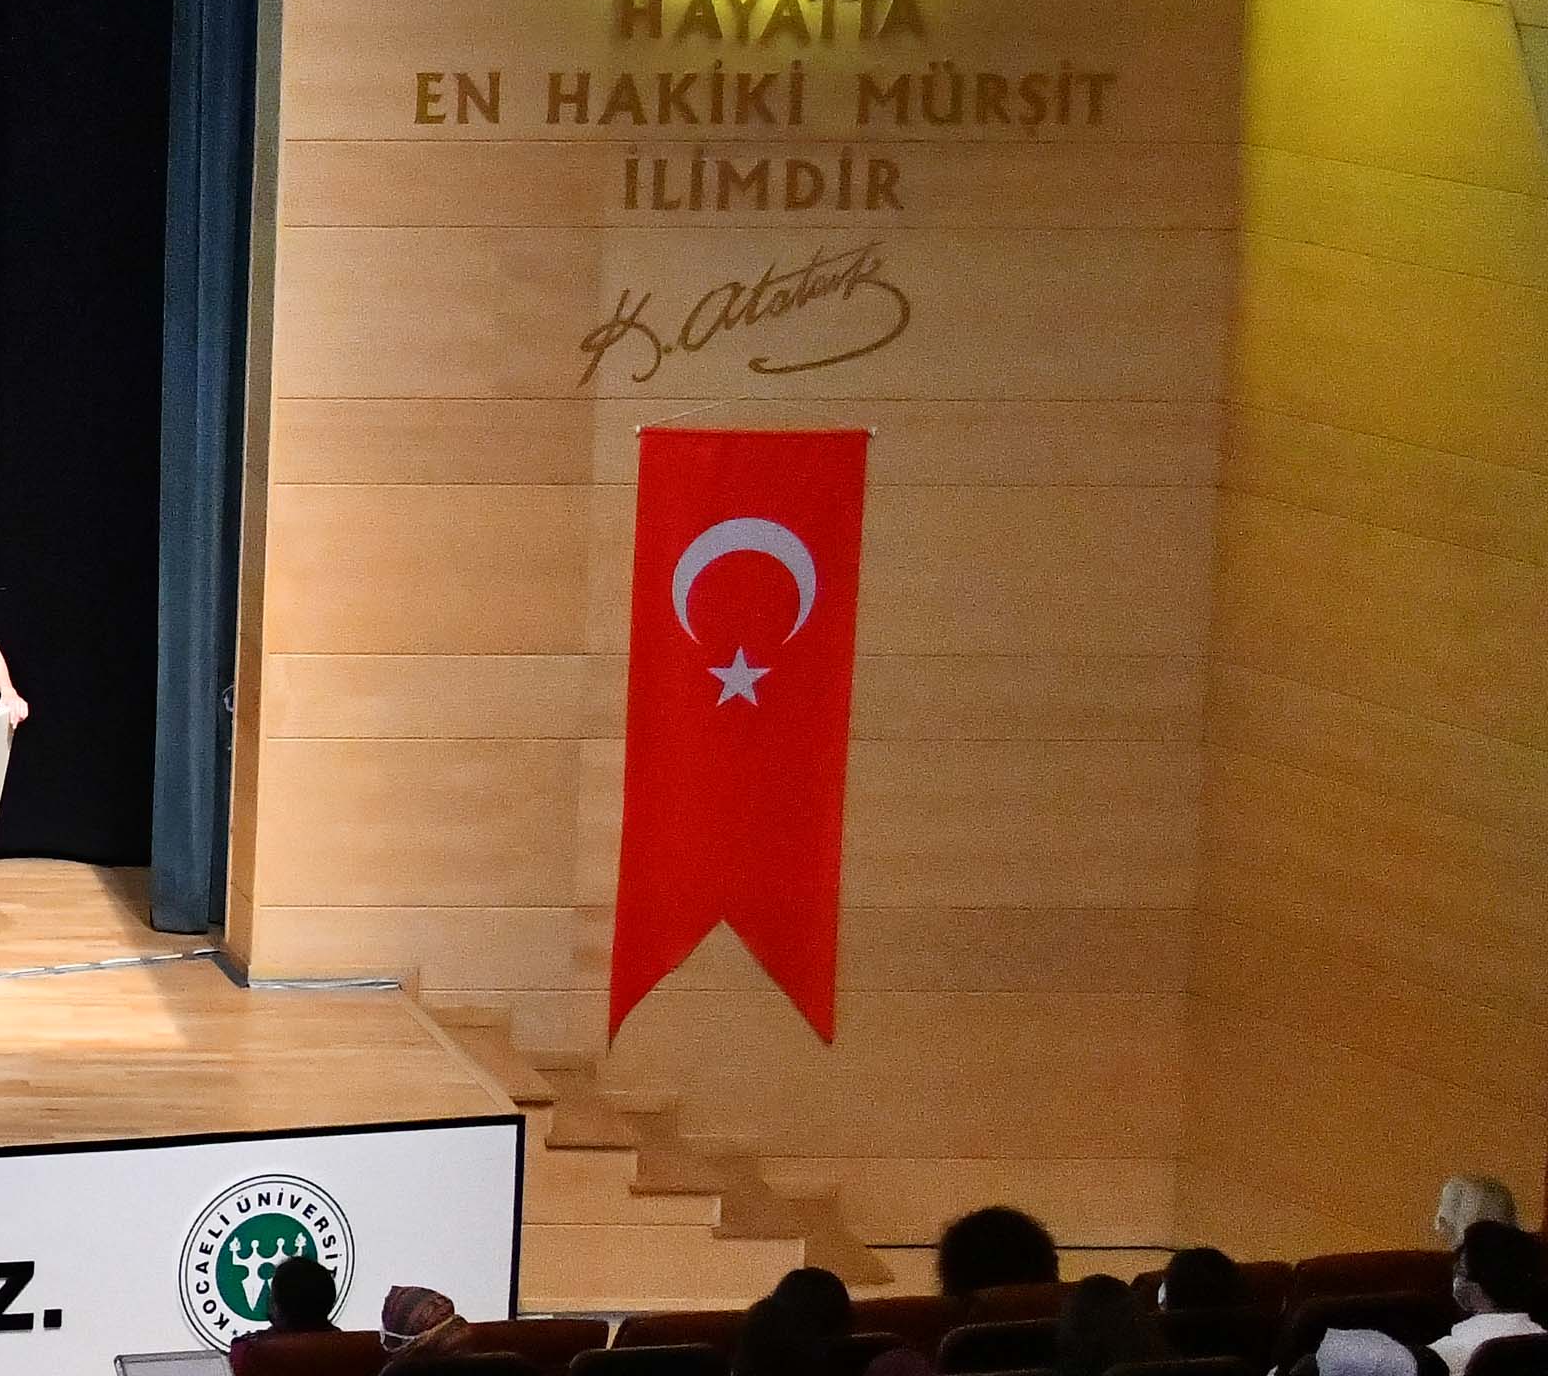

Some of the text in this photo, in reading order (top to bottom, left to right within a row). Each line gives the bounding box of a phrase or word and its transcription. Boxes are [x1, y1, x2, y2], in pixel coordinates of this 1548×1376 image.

[413, 59, 1118, 137] EN HAKİKİ MÜRŞİT
[623, 145, 904, 212] İLİMDİR
[195, 1187, 343, 1331] KOCAELİ ÜNİVERSİT
